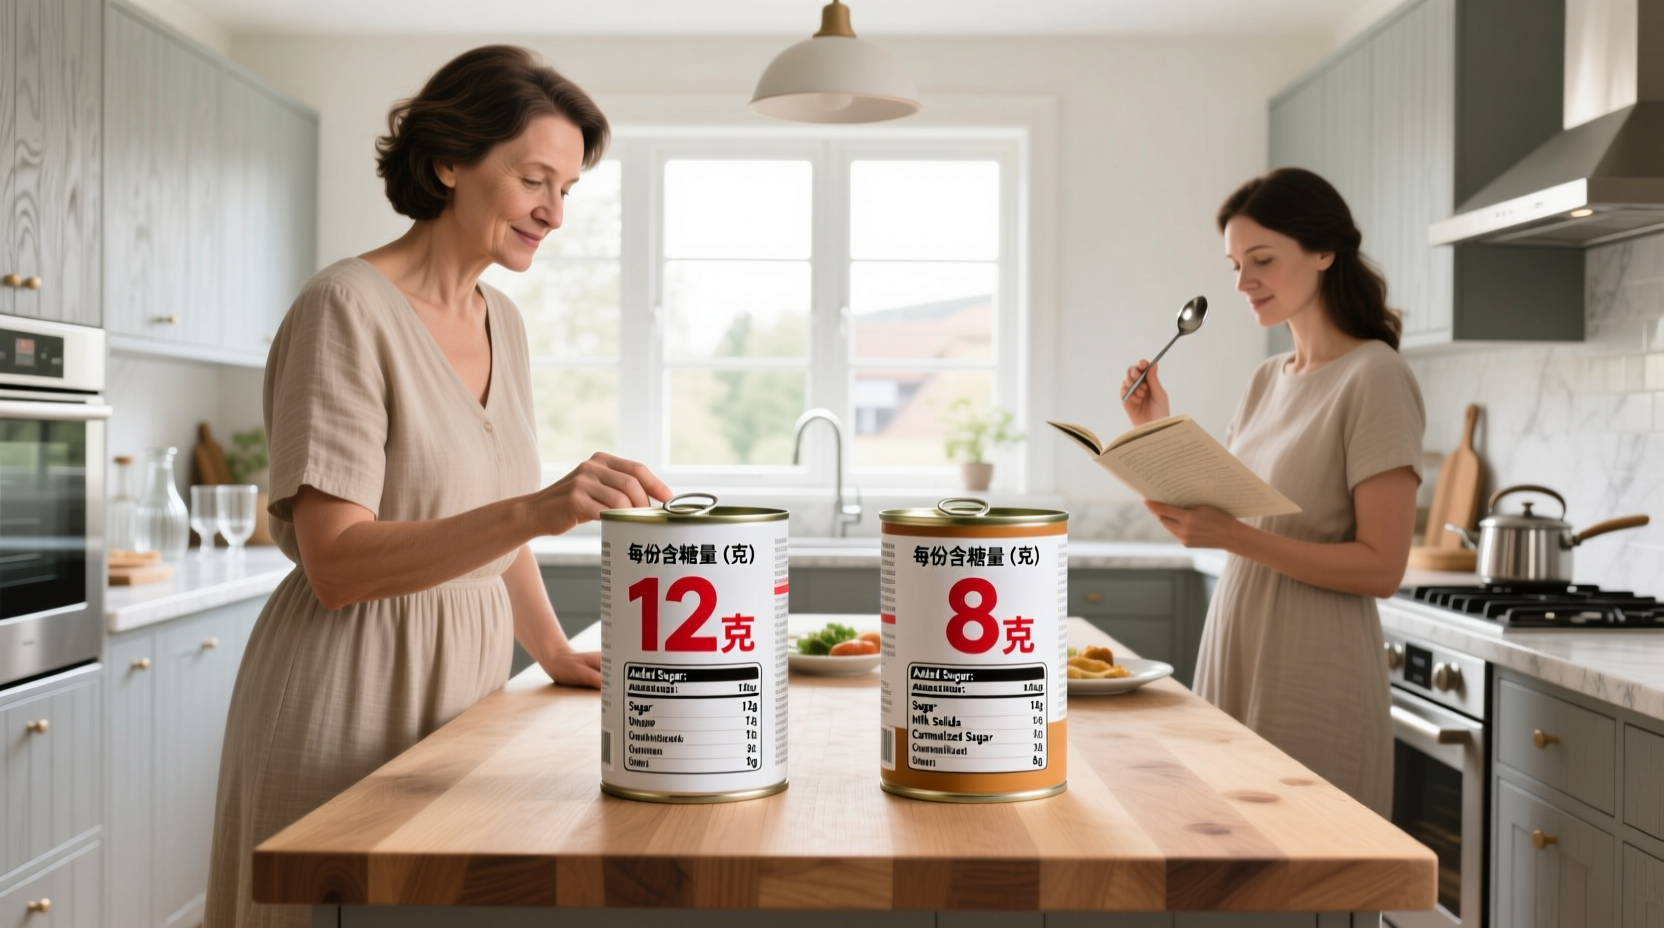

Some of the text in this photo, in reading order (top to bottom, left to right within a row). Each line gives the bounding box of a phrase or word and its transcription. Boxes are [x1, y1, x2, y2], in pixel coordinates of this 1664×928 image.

[627, 542, 718, 565] 每份含糖量
[913, 544, 1005, 567] 每份含糖量
